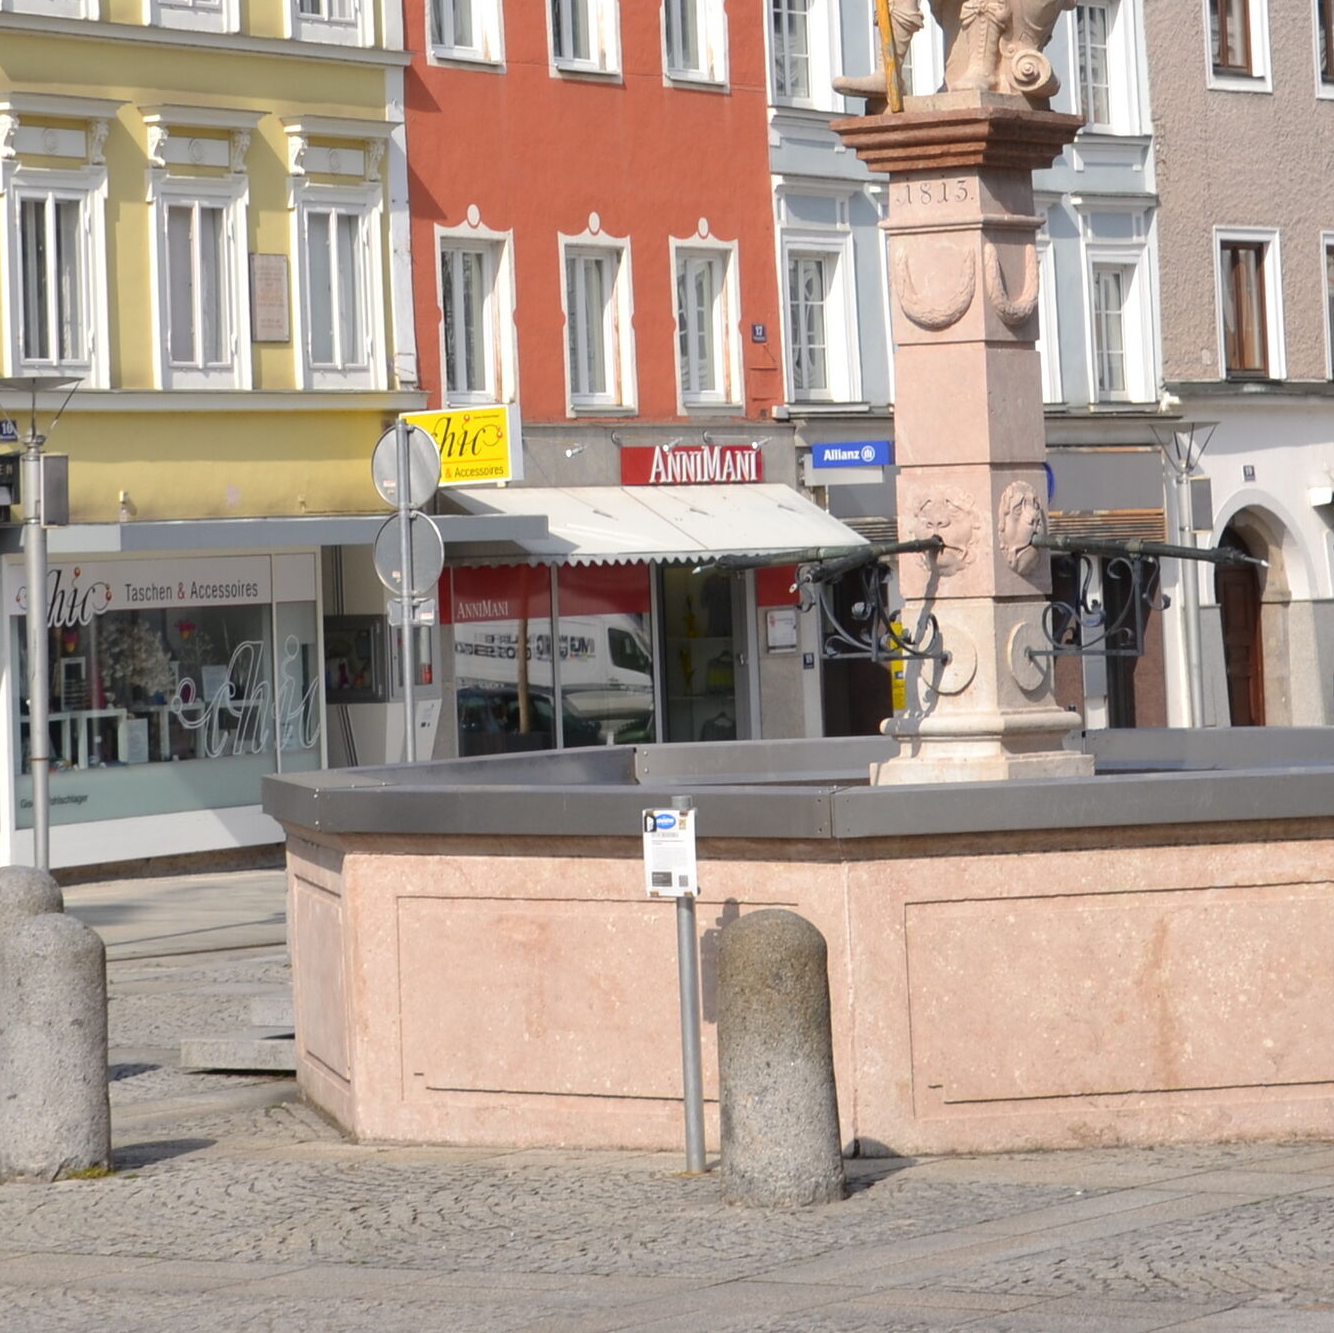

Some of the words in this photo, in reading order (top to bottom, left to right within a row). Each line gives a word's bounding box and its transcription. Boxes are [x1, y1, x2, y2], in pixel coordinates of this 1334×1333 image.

[430, 413, 505, 459] hic
[823, 449, 861, 461] Allianz
[454, 465, 505, 479] Accessoires
[15, 567, 113, 627] hic
[125, 582, 173, 602] Taschen
[177, 580, 185, 600] &
[190, 577, 259, 600] Accessoires
